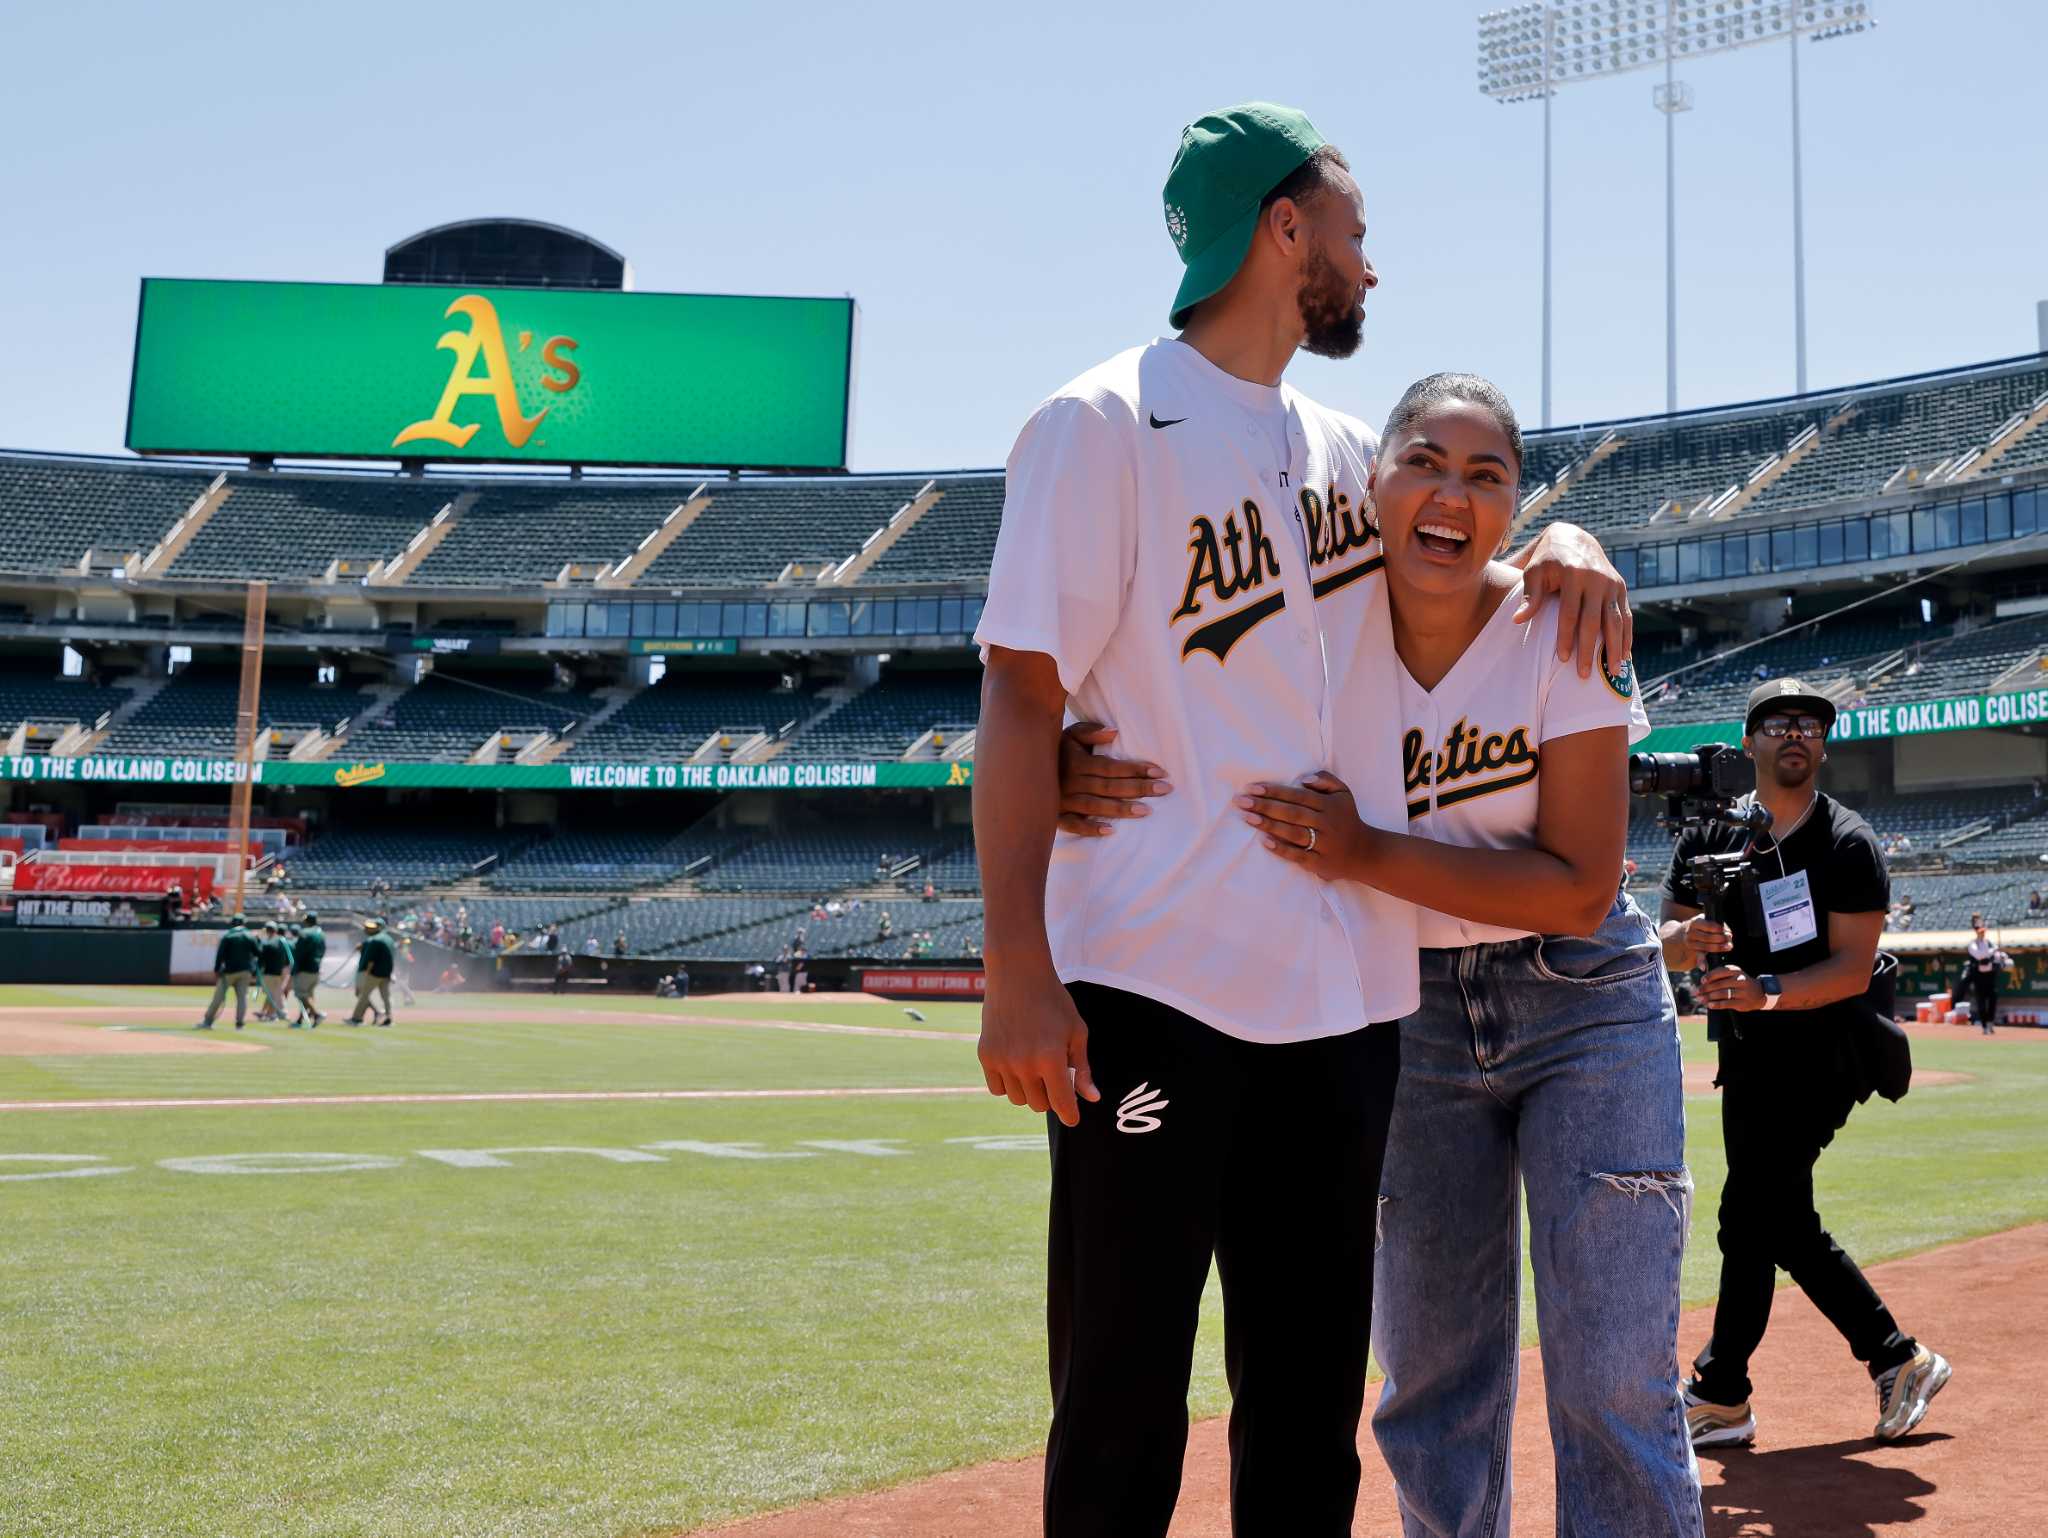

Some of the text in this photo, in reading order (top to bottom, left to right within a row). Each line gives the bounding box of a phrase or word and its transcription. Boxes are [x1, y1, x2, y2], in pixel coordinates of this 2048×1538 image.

[391, 294, 580, 448] A's
[1830, 690, 2048, 739] TO THE OAKLAND COLISE
[10, 756, 34, 778] TO
[41, 757, 76, 779] THE
[81, 757, 166, 781] OAKLAND
[171, 760, 263, 783] COLISEUM
[1402, 714, 1530, 794] letics
[570, 764, 876, 787] WELCOME TO THE OAKLAND COLISEUM
[17, 900, 111, 916] HIT THE BUDS
